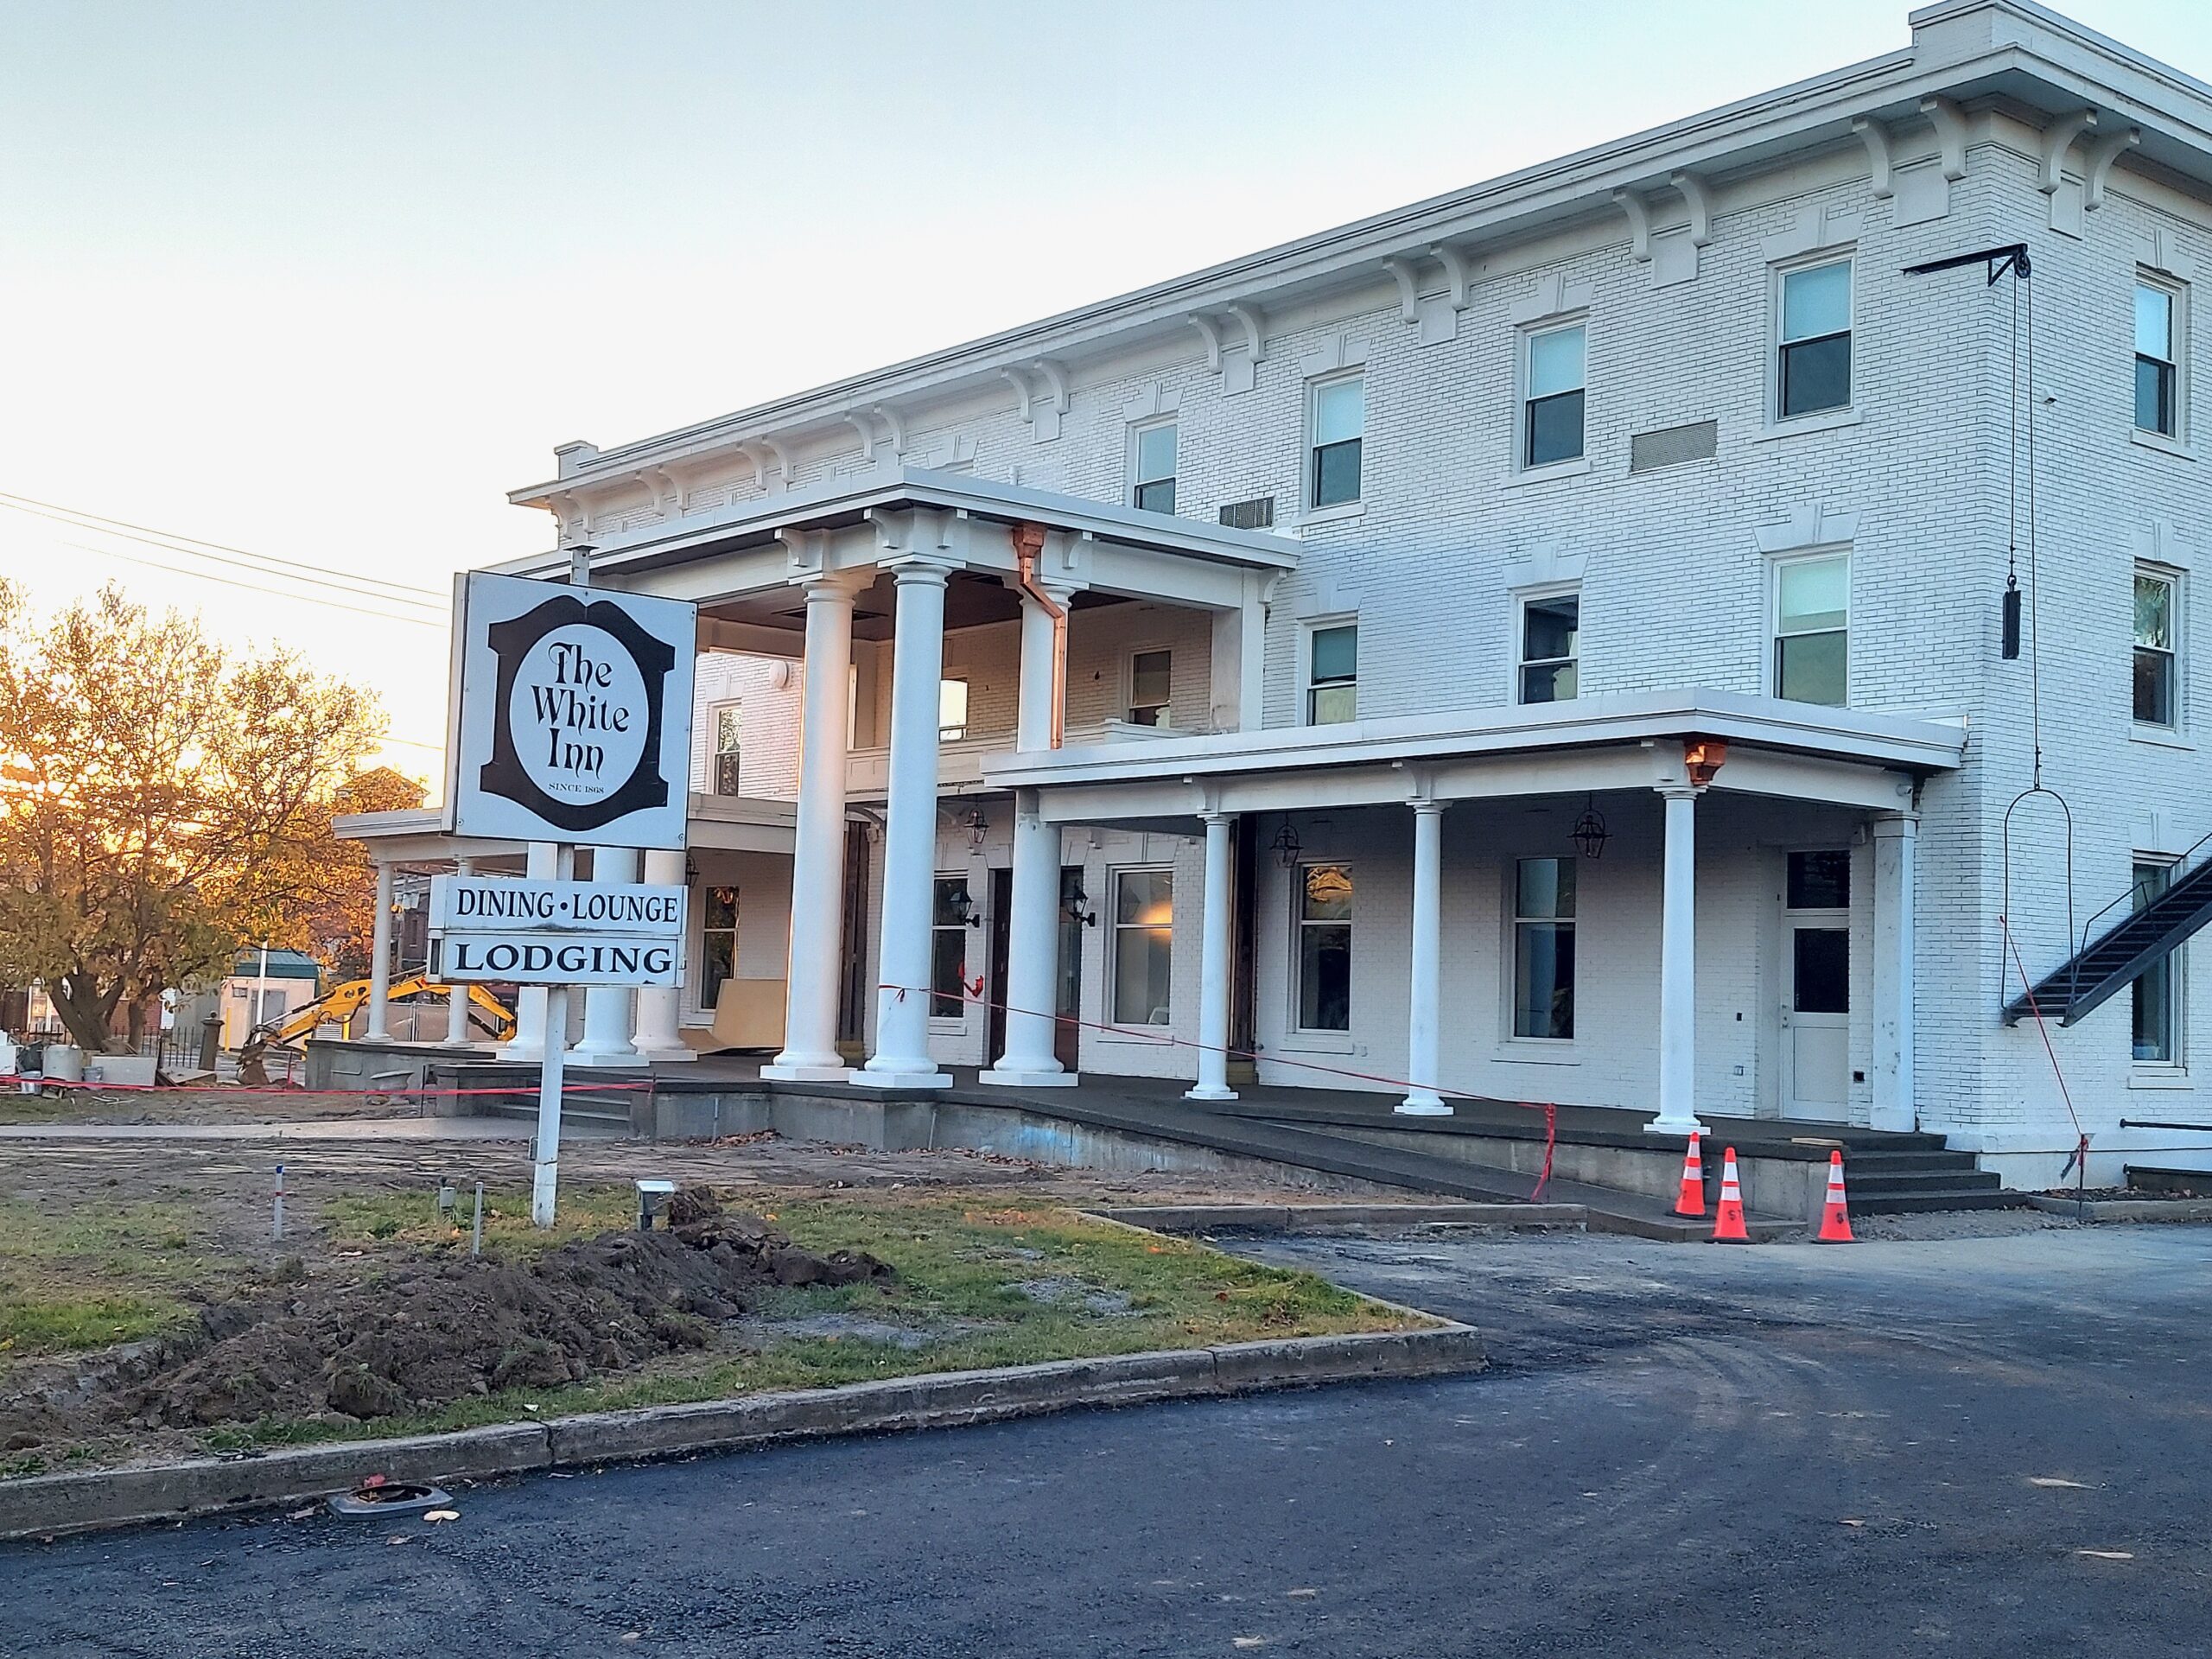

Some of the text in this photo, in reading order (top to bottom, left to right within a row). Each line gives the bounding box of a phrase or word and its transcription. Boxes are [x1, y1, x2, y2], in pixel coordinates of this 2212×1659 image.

[548, 642, 613, 693] The
[531, 685, 630, 736] White
[547, 728, 604, 779] Inn
[548, 783, 605, 794] SINCE 1868
[456, 888, 678, 924] DINING LOUNGE
[454, 943, 673, 974] LODGING
